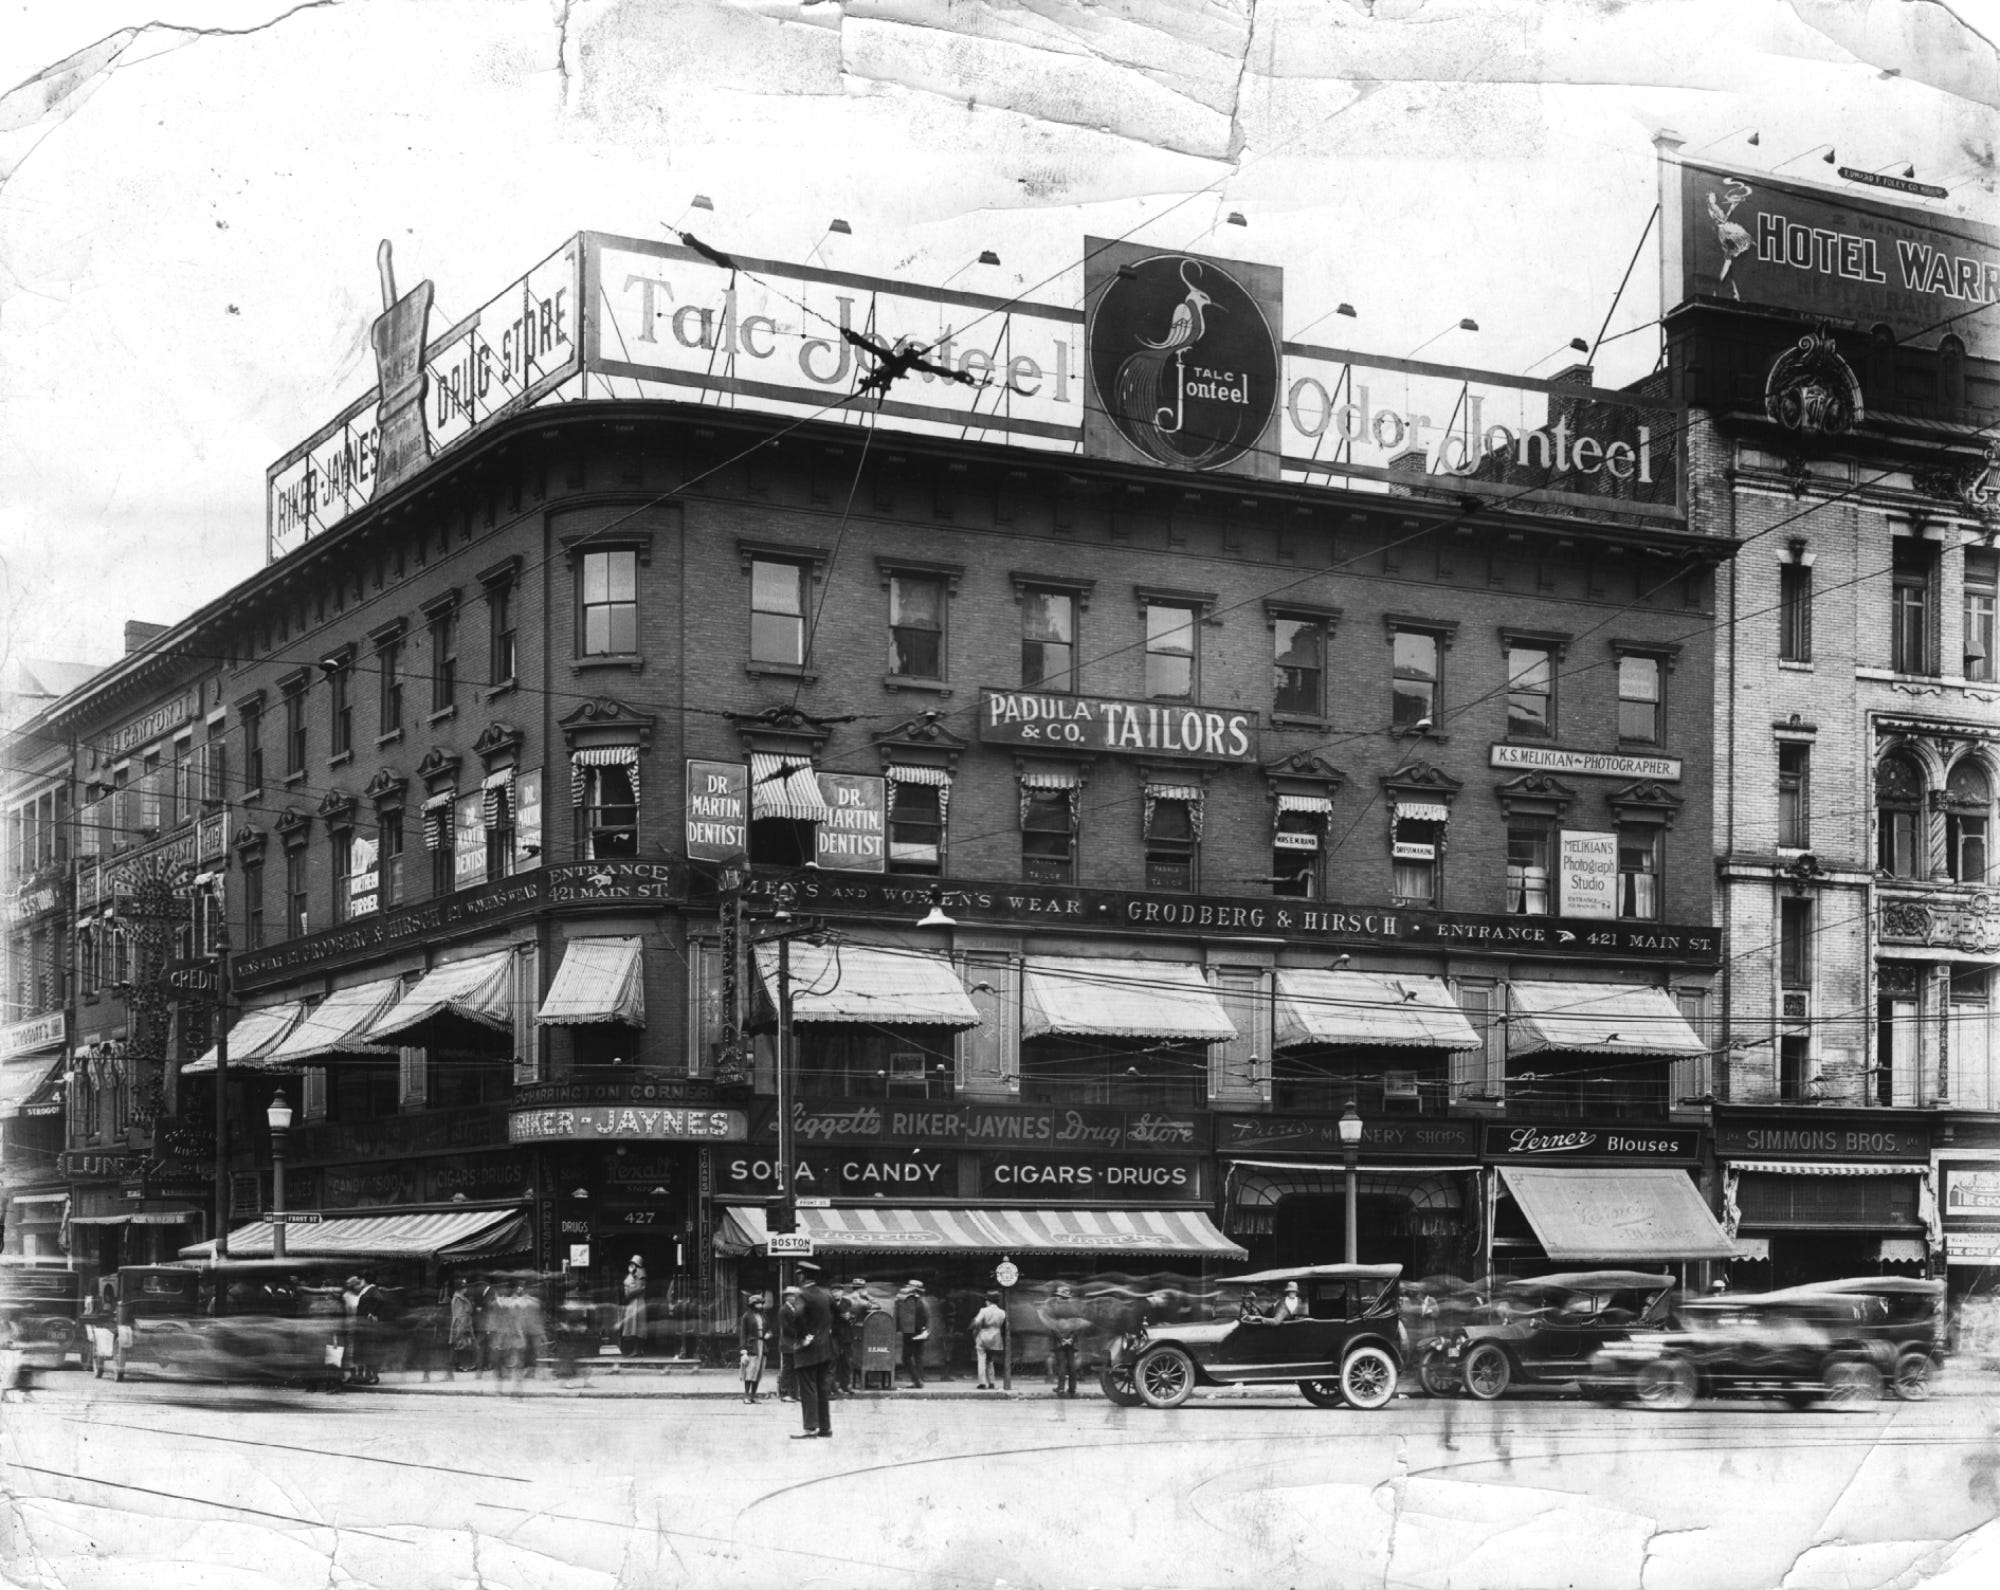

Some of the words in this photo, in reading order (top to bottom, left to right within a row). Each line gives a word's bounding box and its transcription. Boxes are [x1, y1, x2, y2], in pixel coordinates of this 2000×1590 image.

[1758, 212, 1886, 284] HOTEL
[623, 274, 778, 359] Talc
[436, 343, 491, 430] DRUG
[501, 286, 567, 385] STORE
[1194, 366, 1234, 382] TALC
[1155, 346, 1249, 433] Jonteel
[1288, 376, 1430, 451] Odor
[1437, 393, 1653, 483] Jonteel
[990, 693, 1092, 727] PADULA
[1100, 703, 1249, 756] TAILORS
[1021, 724, 1040, 739] &
[1046, 724, 1085, 743] CO.
[1521, 752, 1574, 768] MELIKIAN
[707, 775, 732, 794] DR.
[838, 787, 866, 807] DR.
[688, 822, 745, 847] DENTIST
[819, 832, 883, 857] DENTIST
[549, 864, 670, 884] ENTRANCE
[1563, 855, 1615, 875] Photograph
[549, 885, 575, 900] 421
[580, 886, 633, 898] MAIN
[637, 882, 670, 898] ST.
[1571, 875, 1605, 891] Studio
[832, 887, 868, 899] AND
[1009, 896, 1081, 914] WEAR
[1128, 901, 1266, 928] GRODBERG
[1277, 910, 1293, 929] &
[1304, 911, 1398, 935] HIRSCH
[1437, 923, 1546, 943] ENTRANCE
[1586, 932, 1618, 946] 421
[1629, 934, 1681, 949] MAIN
[1688, 938, 1712, 951] ST.
[52, 1091, 62, 1104] 4
[630, 1084, 714, 1100] CORNER
[1055, 1110, 1121, 1148] Drug
[1127, 1112, 1194, 1143] Store
[1415, 1128, 1466, 1145] SHOPS
[1508, 1127, 1598, 1154] Lerner
[1607, 1135, 1680, 1153] Blouses
[1746, 1129, 1838, 1151] SIMMONS
[1845, 1131, 1901, 1152] BROS.
[481, 1163, 522, 1186] DRUGS
[842, 1161, 943, 1182] CANDY
[994, 1164, 1093, 1184] CIGARS
[1106, 1167, 1187, 1185] DRUGS
[561, 1219, 589, 1233] DRUGS
[624, 1211, 656, 1224] 427
[770, 1238, 811, 1248] BOSTON
